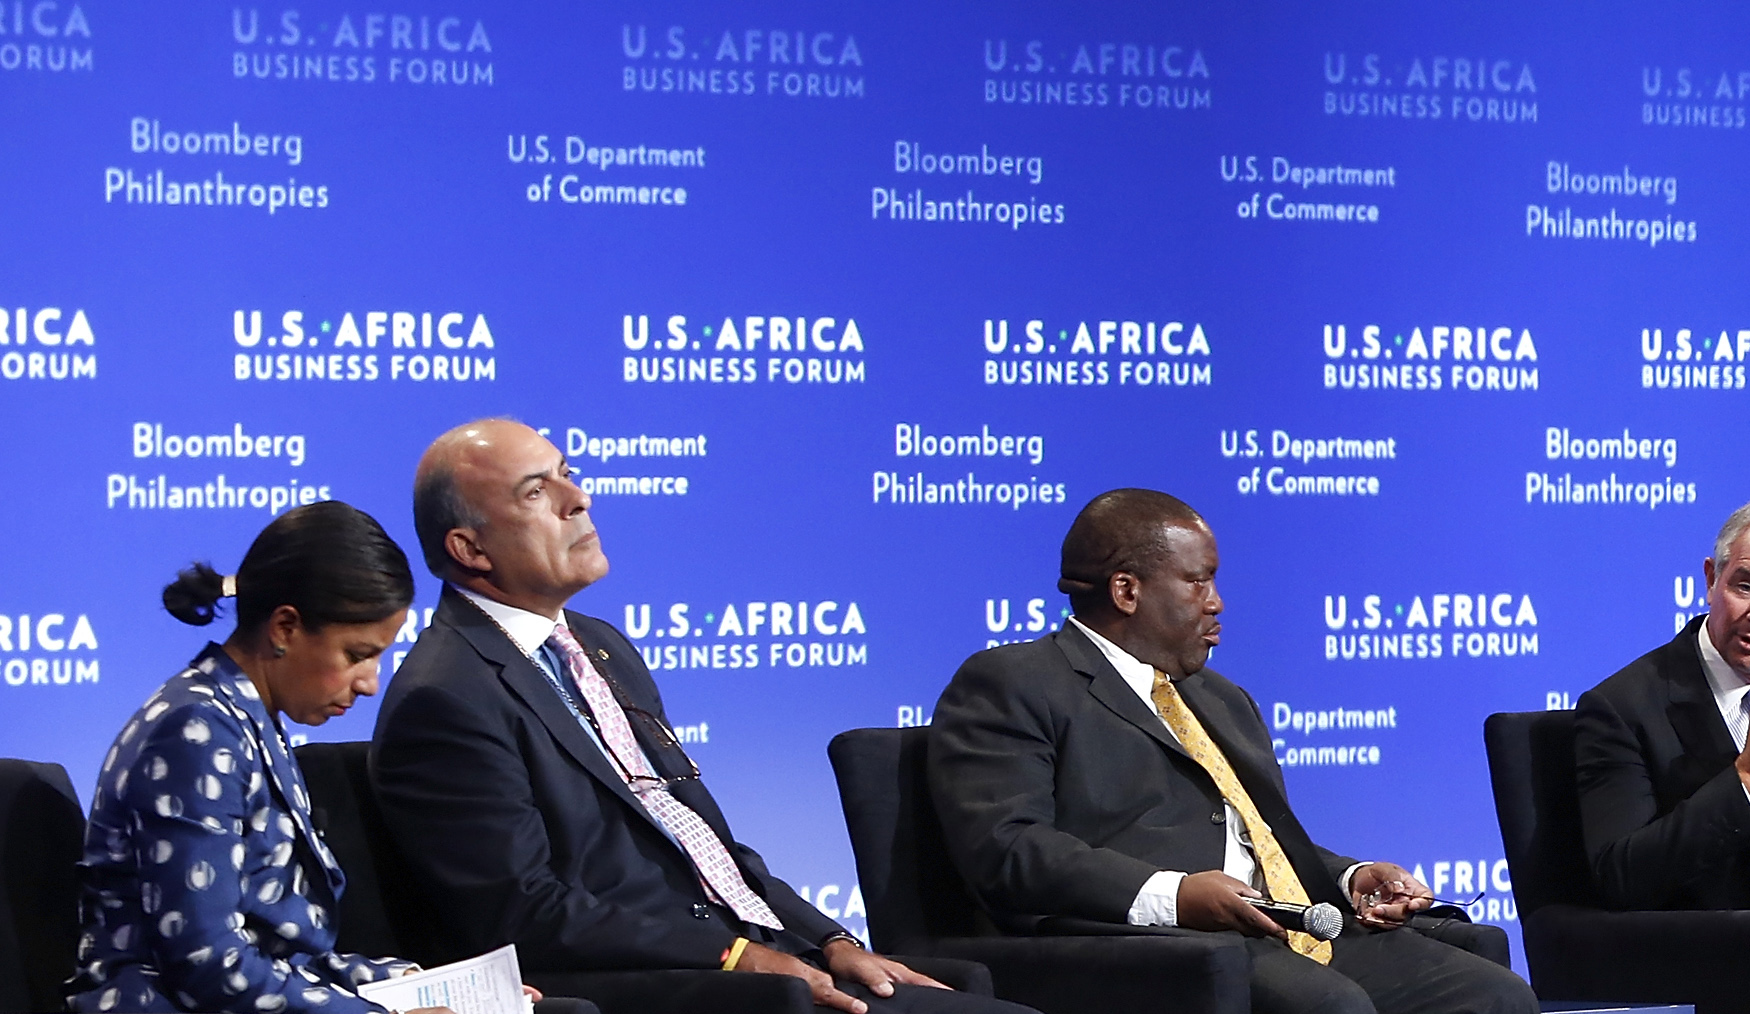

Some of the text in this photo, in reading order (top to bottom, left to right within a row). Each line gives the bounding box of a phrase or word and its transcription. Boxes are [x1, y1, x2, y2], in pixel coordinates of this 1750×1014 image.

[333, 15, 491, 52] AFRICA
[715, 30, 862, 66] AFRICA
[233, 52, 493, 85] BUSINESS FORUM
[1071, 44, 1209, 78] AFRICA
[623, 66, 864, 97] BUSINESS FORUM
[985, 79, 1210, 109] BUSINESS FORUM
[1642, 103, 1745, 128] BUSINESS
[131, 117, 302, 165] Bloomberg
[508, 135, 704, 170] U.S. Department
[895, 141, 1042, 184] Bloomberg
[1221, 156, 1395, 189] U.S. Department
[106, 168, 328, 214] Philanthropies
[527, 175, 686, 205] of Commerce
[1547, 161, 1676, 204] Bloomberg
[873, 187, 1064, 230] Philanthropies
[1238, 193, 1379, 222] of Commerce
[1527, 205, 1696, 247] Philanthropies
[234, 310, 494, 348] U.S. AFRICA
[624, 315, 863, 351] U.S. AFRICA
[985, 320, 1210, 355] U.S. AFRICA
[1324, 325, 1537, 361] U.S. AFRICA
[1642, 329, 1701, 361] U.S.
[1, 352, 97, 379] ORUM
[235, 354, 495, 381] BUSINESS FORUM
[624, 357, 864, 383] BUSINESS FORUM
[985, 360, 1210, 385] BUSINESS FORUM
[1324, 364, 1538, 390] BUSINESS FORUM
[1642, 365, 1745, 388] BUSINESS
[133, 422, 304, 466] Bloomberg
[566, 427, 706, 462] Department
[896, 424, 1042, 464] Bloomberg
[1221, 430, 1395, 463] U.S. Department
[1546, 427, 1676, 467] Bloomberg
[108, 474, 332, 516] Philanthropies
[569, 467, 689, 495] ommerce
[873, 471, 1065, 510] Philanthropies
[1238, 467, 1379, 494] of Commerce
[1526, 472, 1696, 509] Philanthropies
[624, 601, 865, 639] U.S. AFRICA
[985, 598, 1058, 632] U.S.
[1325, 594, 1537, 629] U.S. AFRICA
[635, 643, 866, 671] USINESS FORUM
[1326, 633, 1538, 659] BUSINESS FORUM
[0, 658, 99, 685] ORUM
[1273, 702, 1396, 734] Department
